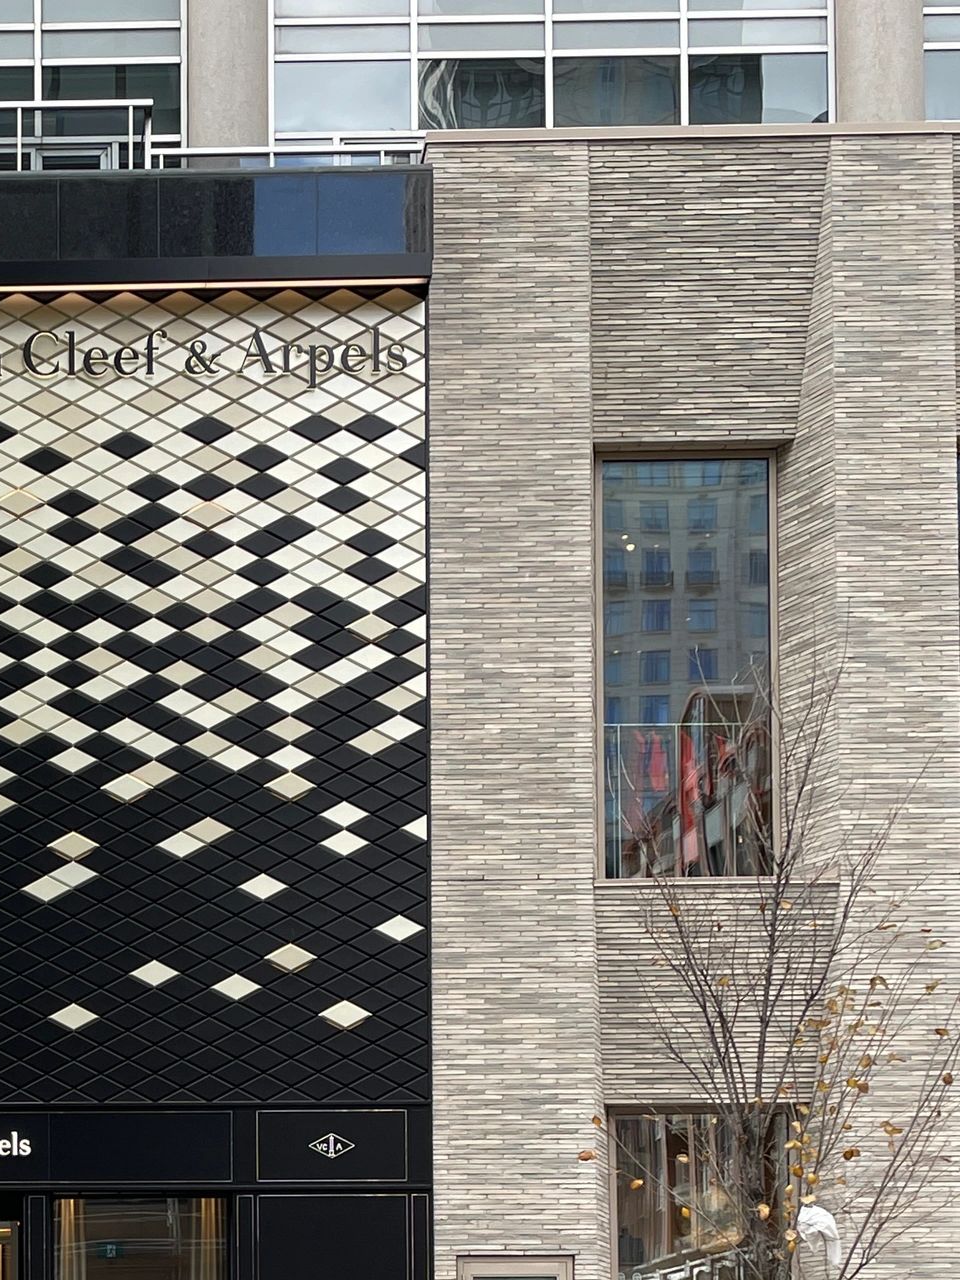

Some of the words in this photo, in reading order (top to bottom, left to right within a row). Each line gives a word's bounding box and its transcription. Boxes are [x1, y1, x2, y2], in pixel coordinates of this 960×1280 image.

[22, 329, 168, 379] Cleef
[184, 339, 221, 375] &
[237, 327, 408, 391] Arpels
